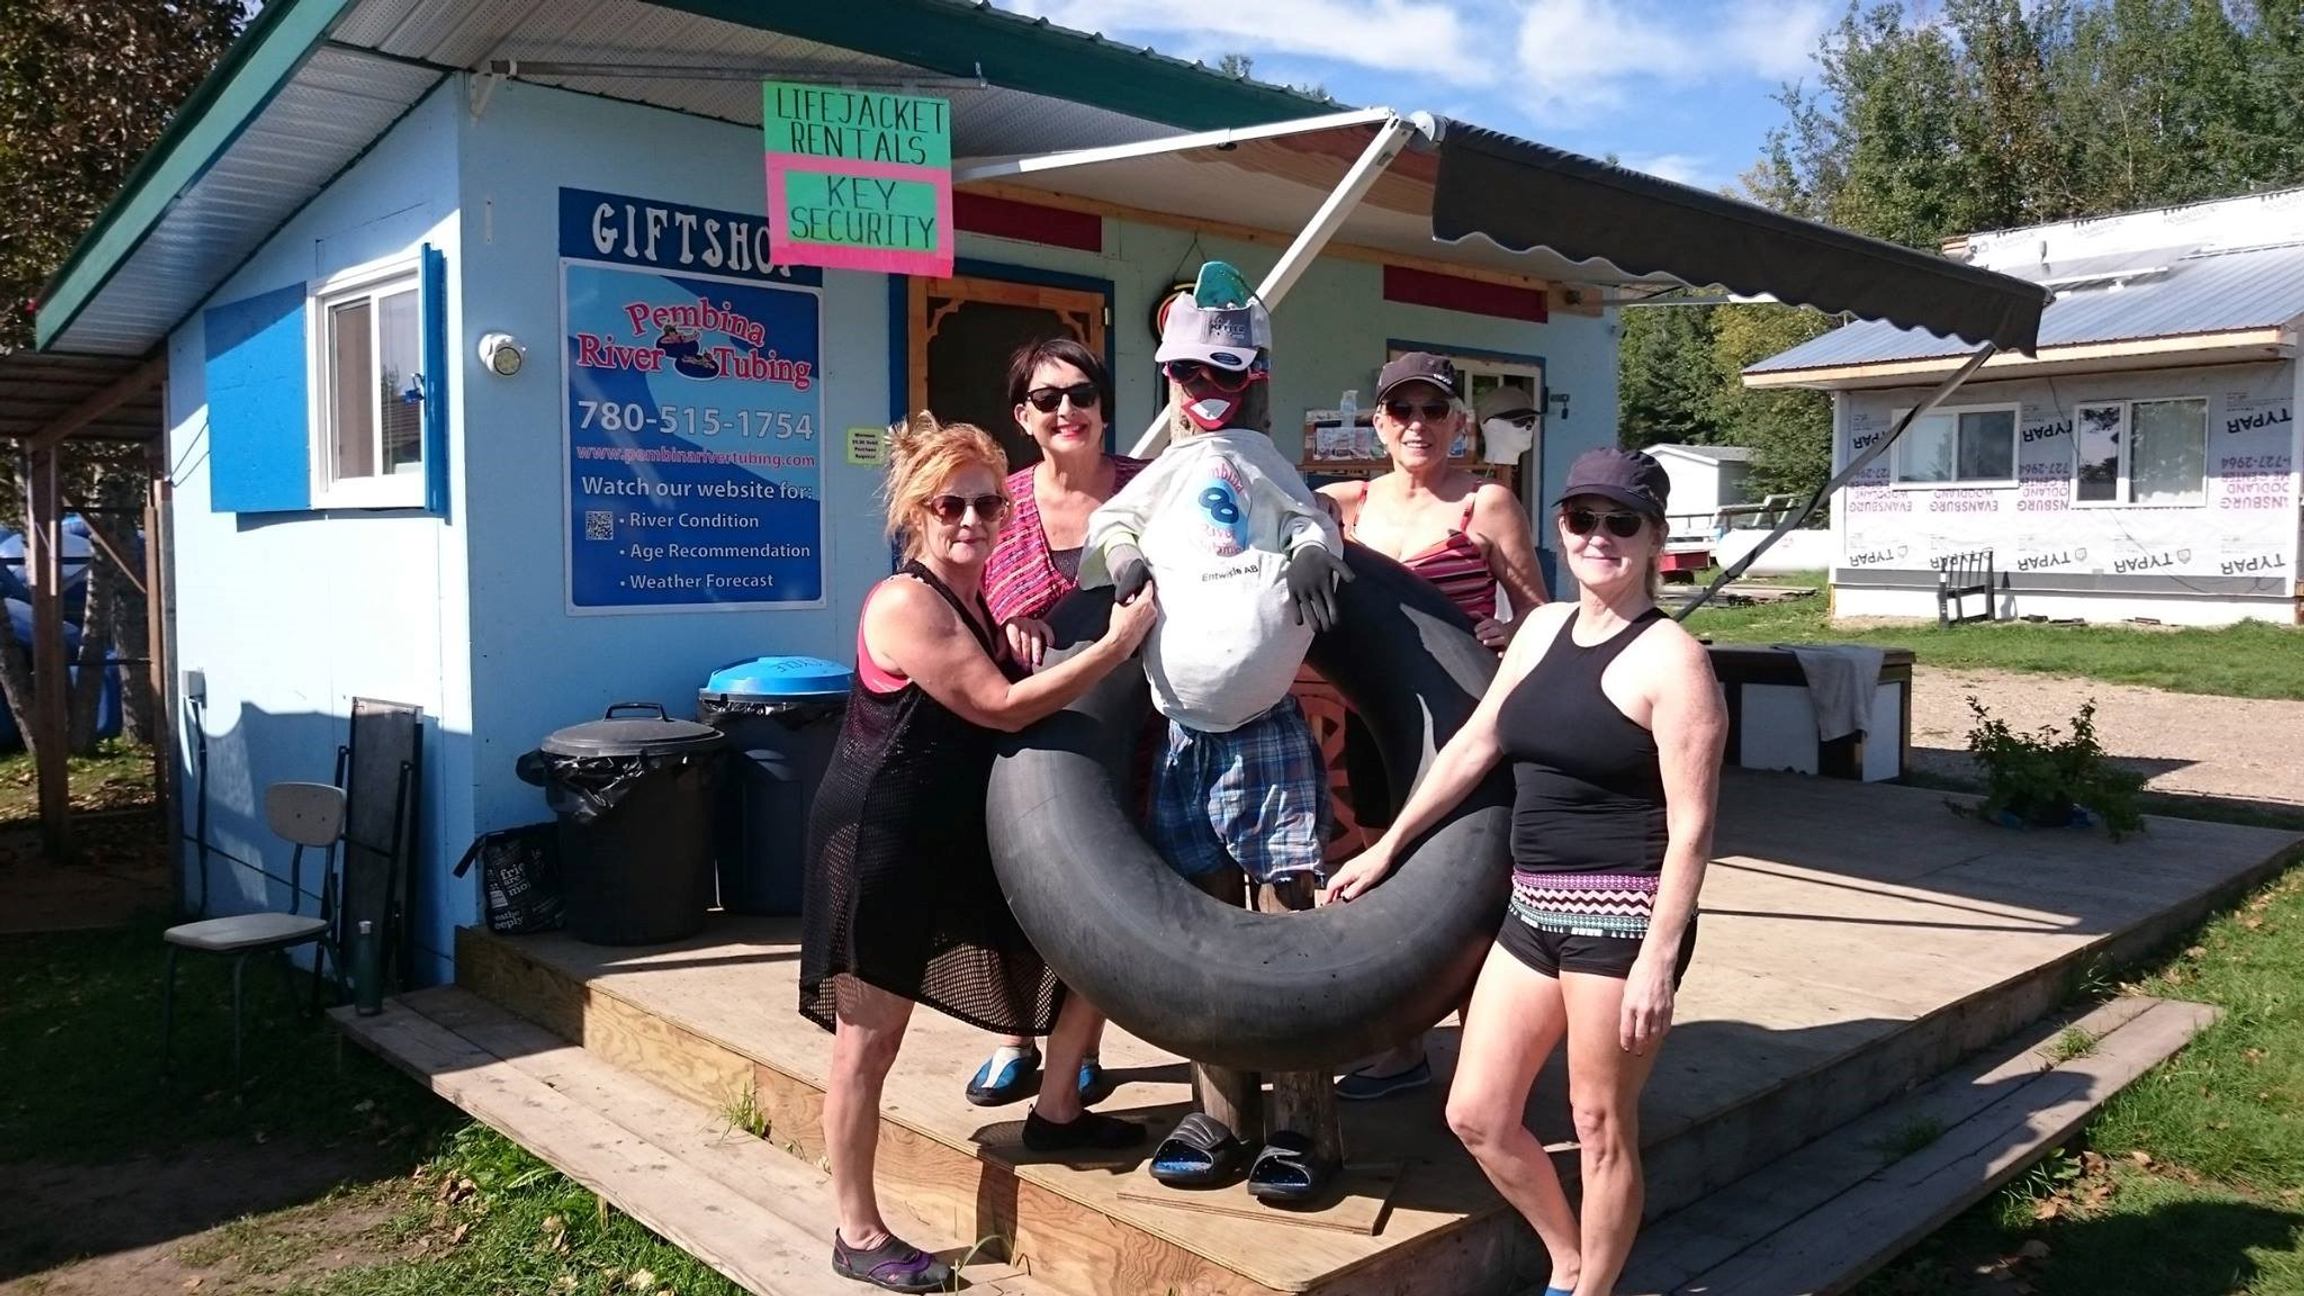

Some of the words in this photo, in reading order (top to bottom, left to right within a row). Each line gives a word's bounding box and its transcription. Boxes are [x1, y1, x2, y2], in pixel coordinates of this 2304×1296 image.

[776, 87, 945, 135] LIFEJACKET
[790, 121, 927, 166] RENTALS
[826, 176, 897, 211] KEY
[591, 202, 793, 278] GIFTSHO
[790, 207, 935, 249] SECURITY
[624, 296, 767, 347] Pembina
[576, 333, 665, 373] River
[709, 347, 812, 392] Tubing
[577, 400, 814, 440] 780-515-1754
[2226, 407, 2293, 434] TYPAR
[1852, 431, 1888, 450] PAR
[576, 445, 816, 469] www.pembinarivertubing.com
[581, 476, 650, 496] Watch
[655, 481, 693, 497] our
[697, 480, 775, 499] website
[779, 481, 814, 500] for:
[629, 512, 673, 528] River
[678, 512, 760, 529] Condition
[629, 544, 664, 563] Age
[669, 543, 811, 559] Recommendation
[1848, 548, 1895, 568] TYPAR
[2016, 551, 2072, 571] TYPAR
[2113, 550, 2174, 574] TYPAR
[2220, 552, 2286, 576] TYPAR
[1244, 563, 1259, 575] AB
[629, 574, 702, 590] Weather
[706, 573, 774, 588] Forecast
